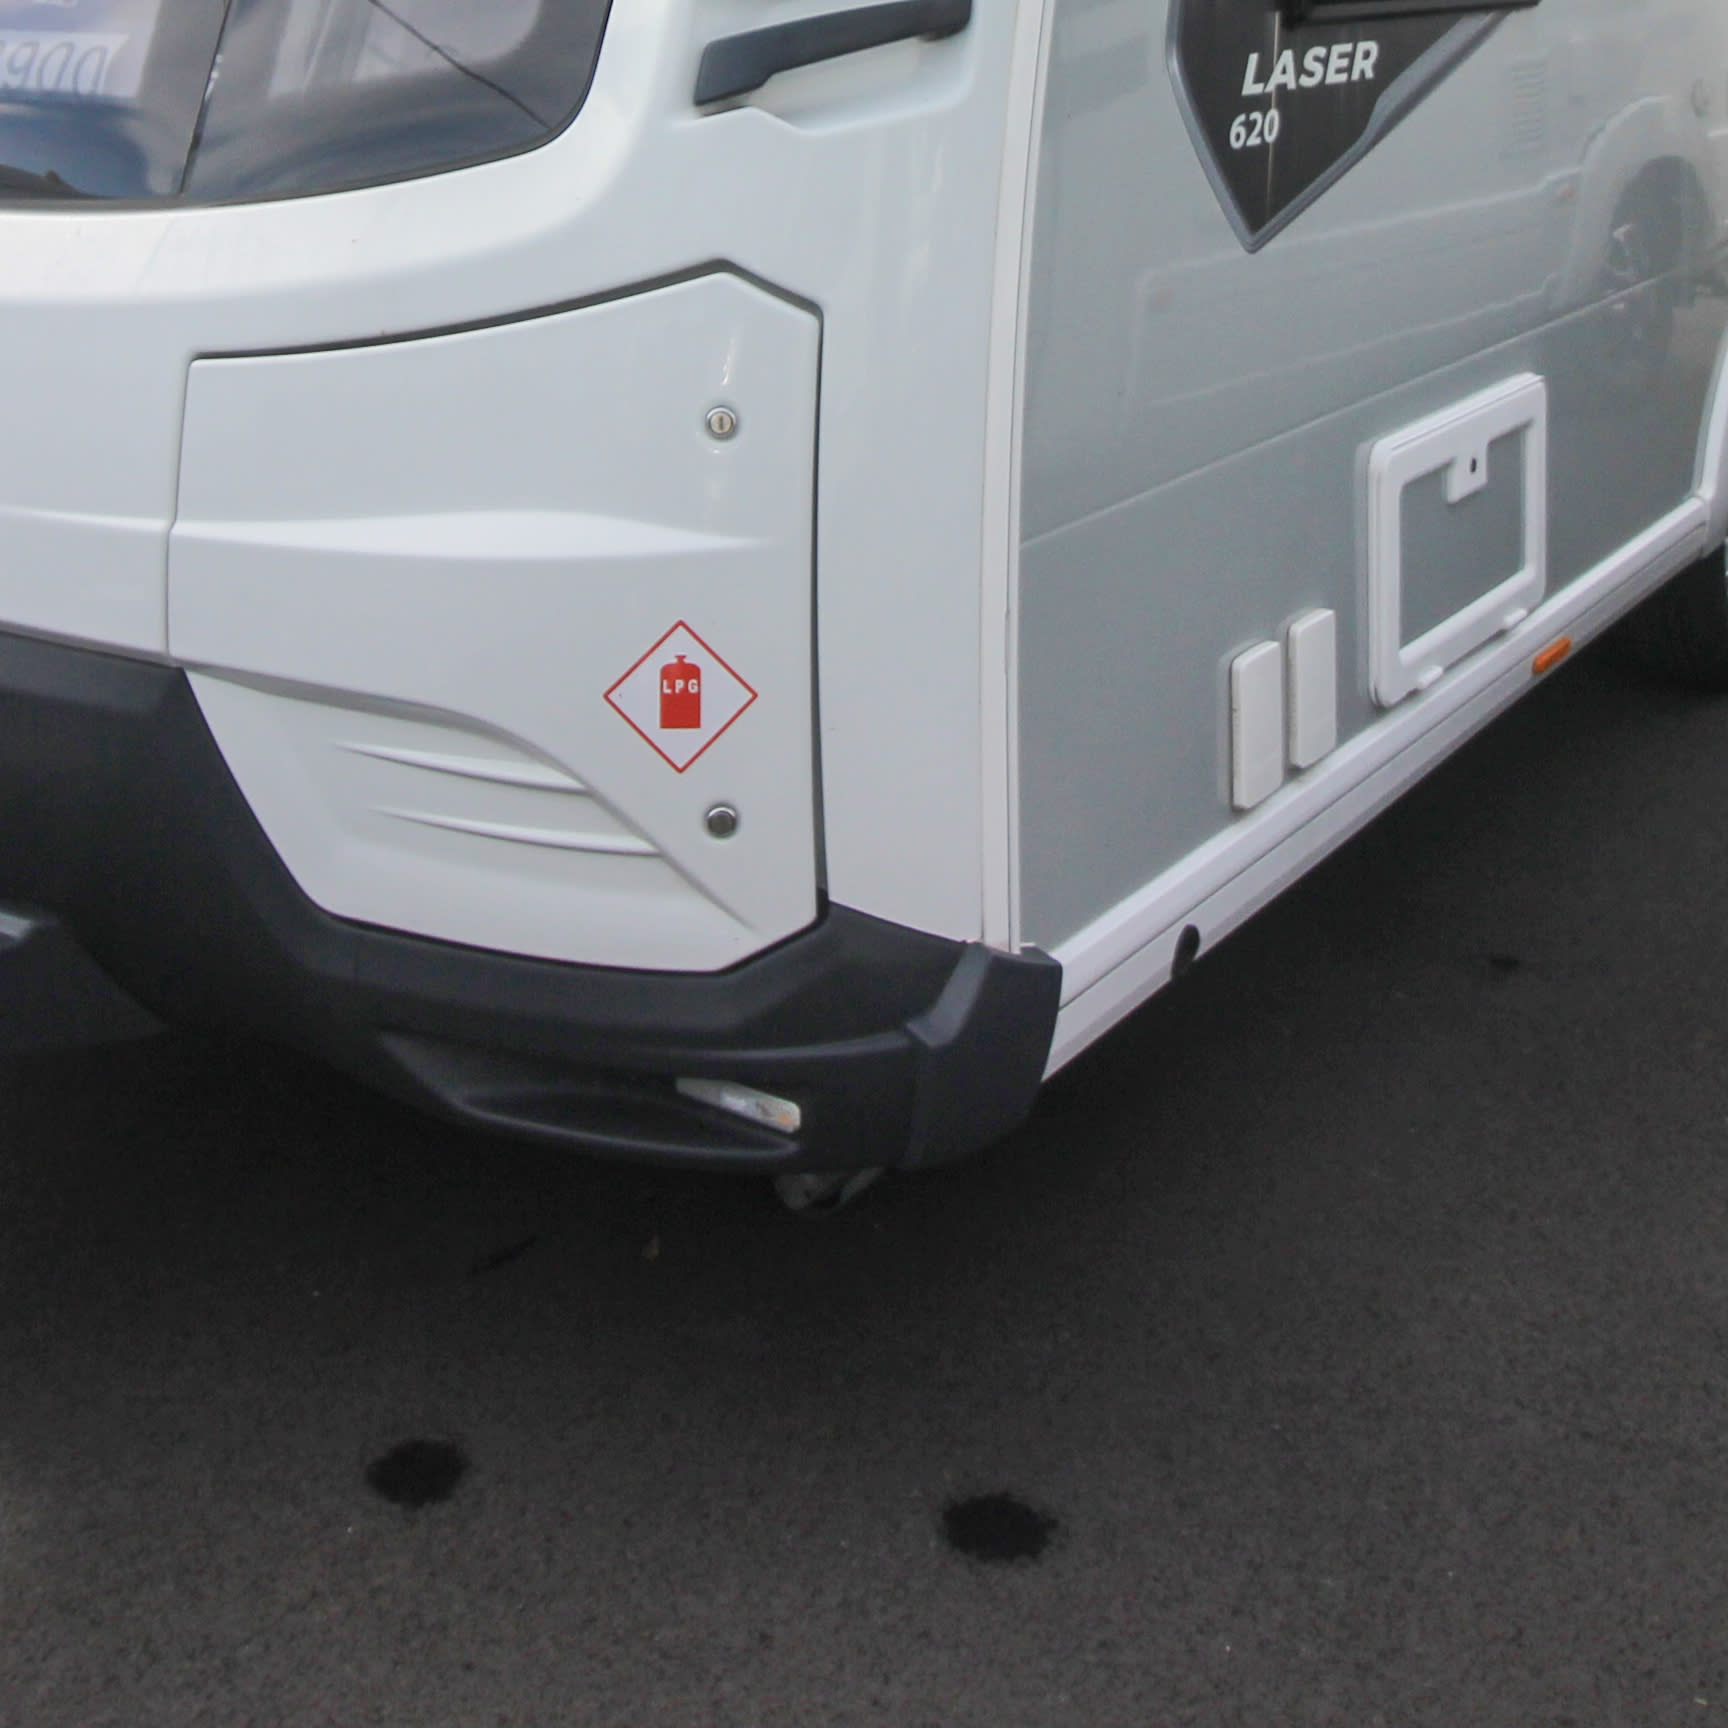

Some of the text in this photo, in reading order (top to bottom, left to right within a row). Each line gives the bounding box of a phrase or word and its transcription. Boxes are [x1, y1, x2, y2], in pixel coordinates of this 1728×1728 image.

[1240, 40, 1380, 97] LASER
[1228, 108, 1280, 150] 620
[662, 679, 699, 694] LPG
